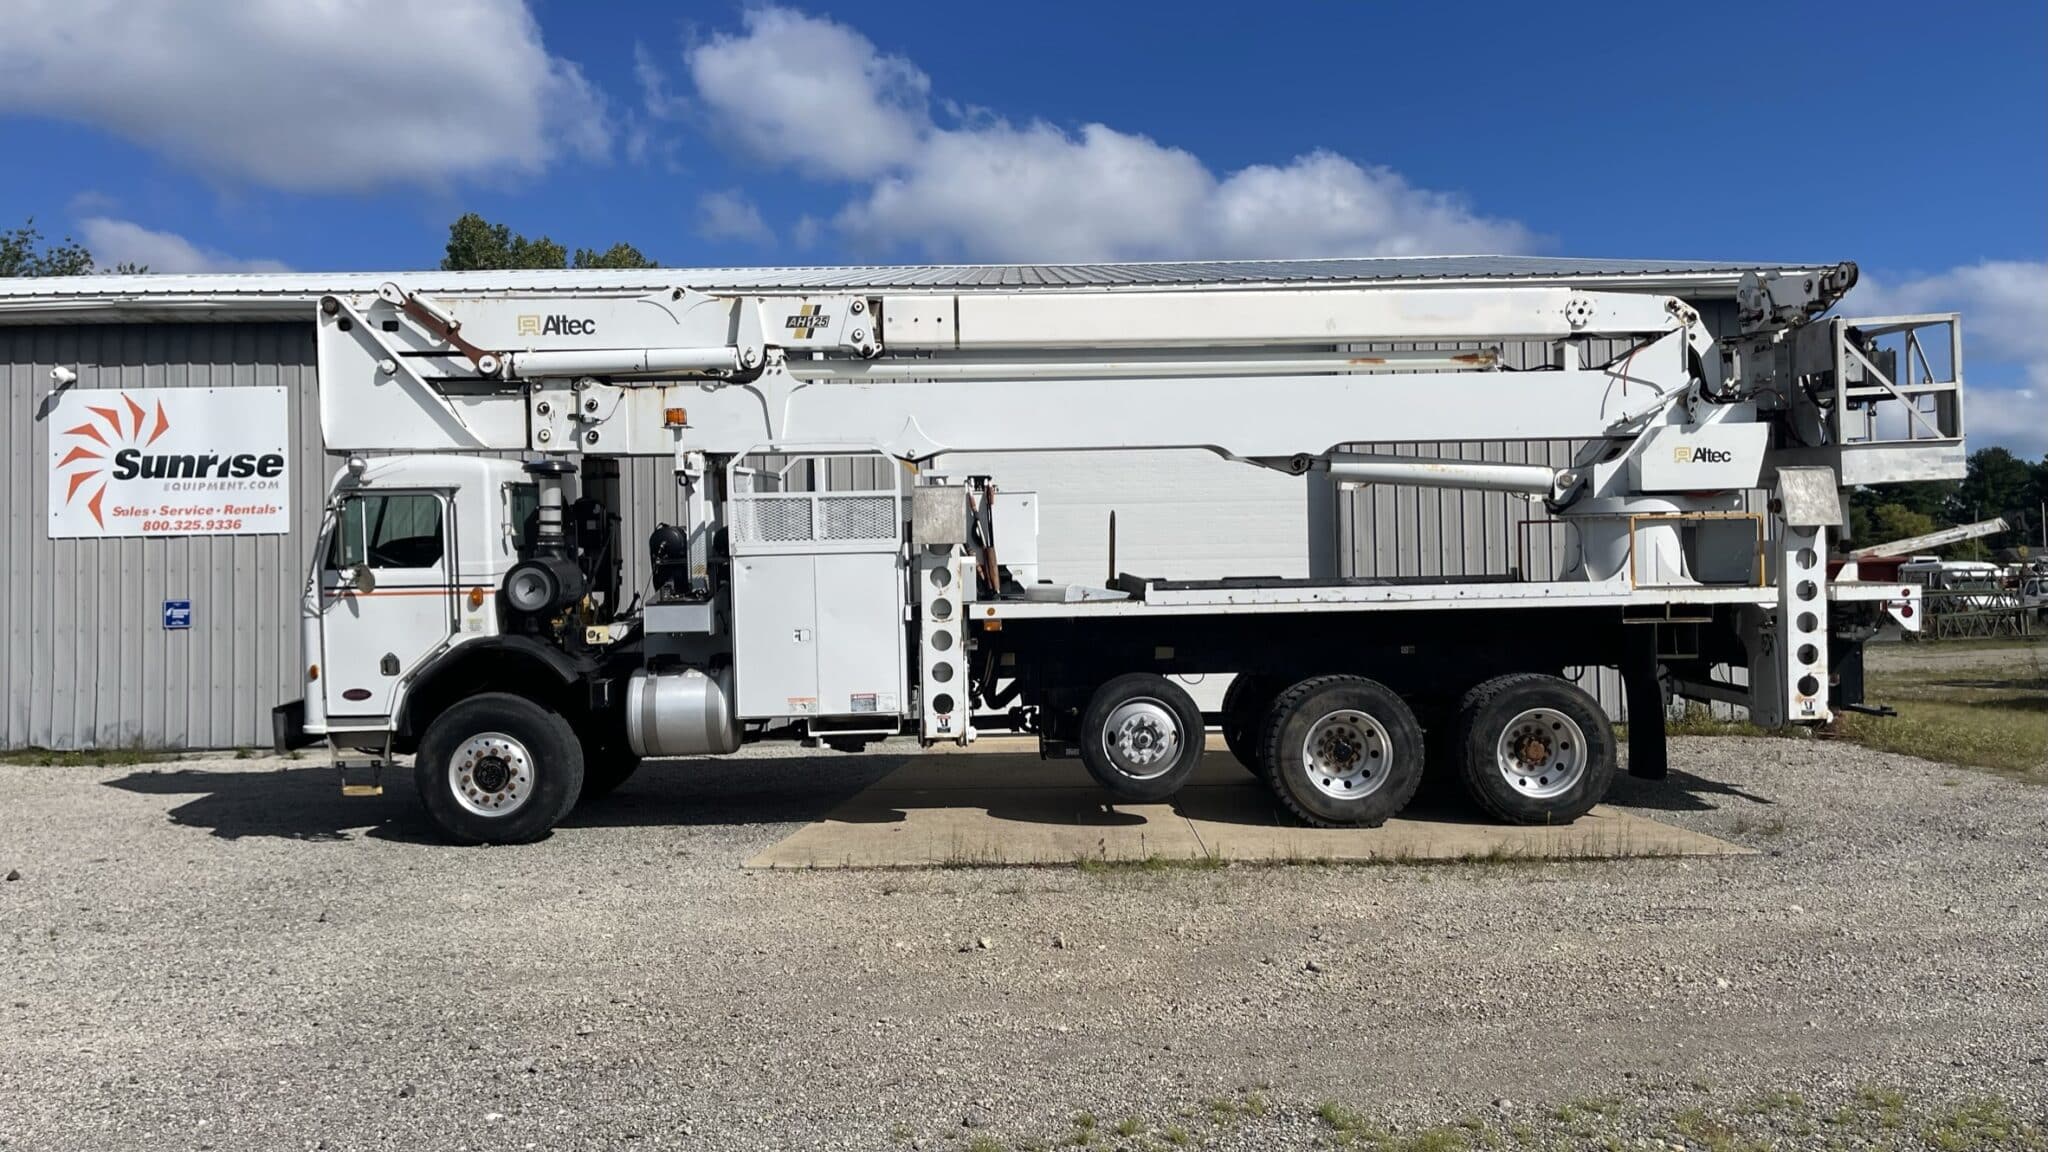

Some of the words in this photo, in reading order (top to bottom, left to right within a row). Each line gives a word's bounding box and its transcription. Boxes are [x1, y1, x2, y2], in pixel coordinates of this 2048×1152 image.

[542, 314, 596, 335] Altec
[788, 316, 828, 327] AH125
[1692, 447, 1732, 463] Altec
[112, 448, 284, 480] Sunrise
[163, 481, 279, 491] EQUIPMENT.COM
[112, 506, 149, 517] Sales
[159, 505, 214, 516] Service
[223, 504, 276, 515] Rentals
[143, 519, 242, 532] 800.325.9336
